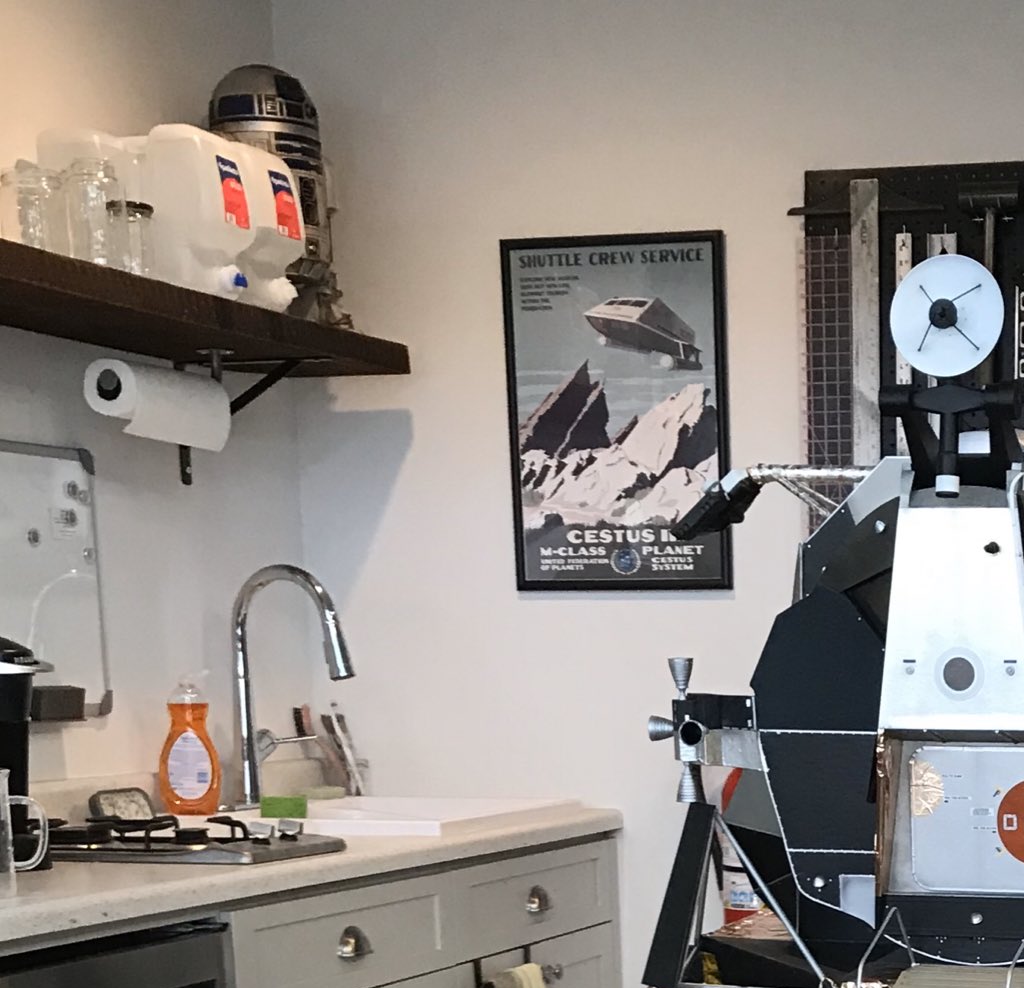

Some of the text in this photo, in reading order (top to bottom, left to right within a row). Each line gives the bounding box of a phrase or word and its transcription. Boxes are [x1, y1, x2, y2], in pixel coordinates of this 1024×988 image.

[519, 248, 704, 269] SHUTTLE CREW SERVICE
[566, 529, 681, 543] CESTUS II
[540, 546, 607, 556] M-CLASS
[642, 545, 704, 555] PLANET
[651, 563, 694, 571] SYSTEM
